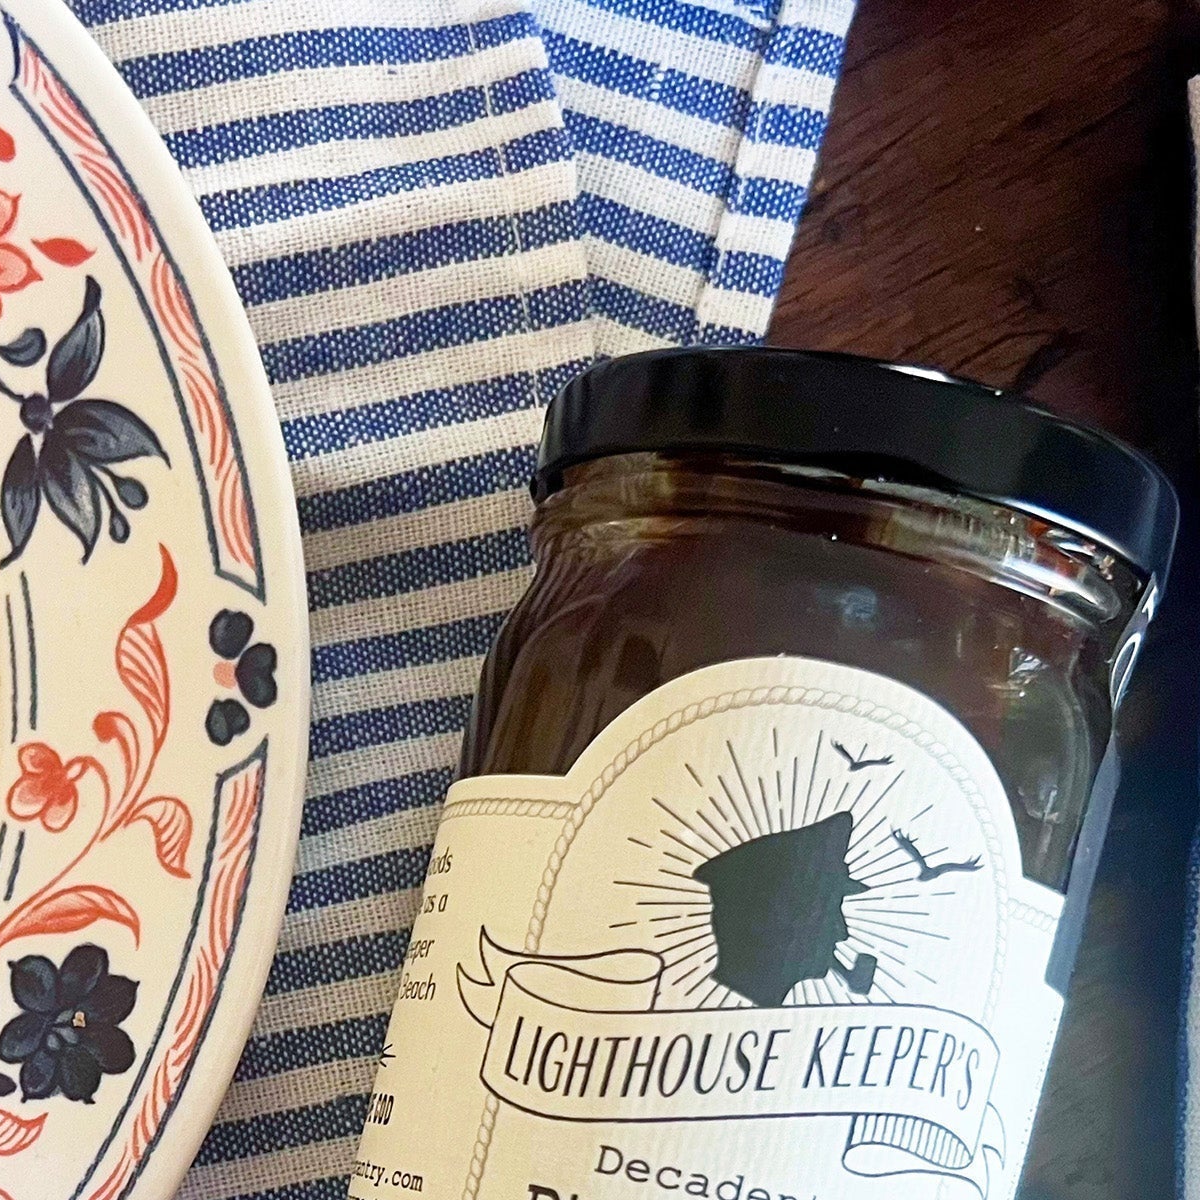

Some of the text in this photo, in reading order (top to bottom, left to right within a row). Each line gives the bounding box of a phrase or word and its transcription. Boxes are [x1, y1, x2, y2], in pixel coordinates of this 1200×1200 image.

[438, 893, 449, 913] a
[503, 1016, 980, 1110] LIGHTHOUSE KEEPER'S
